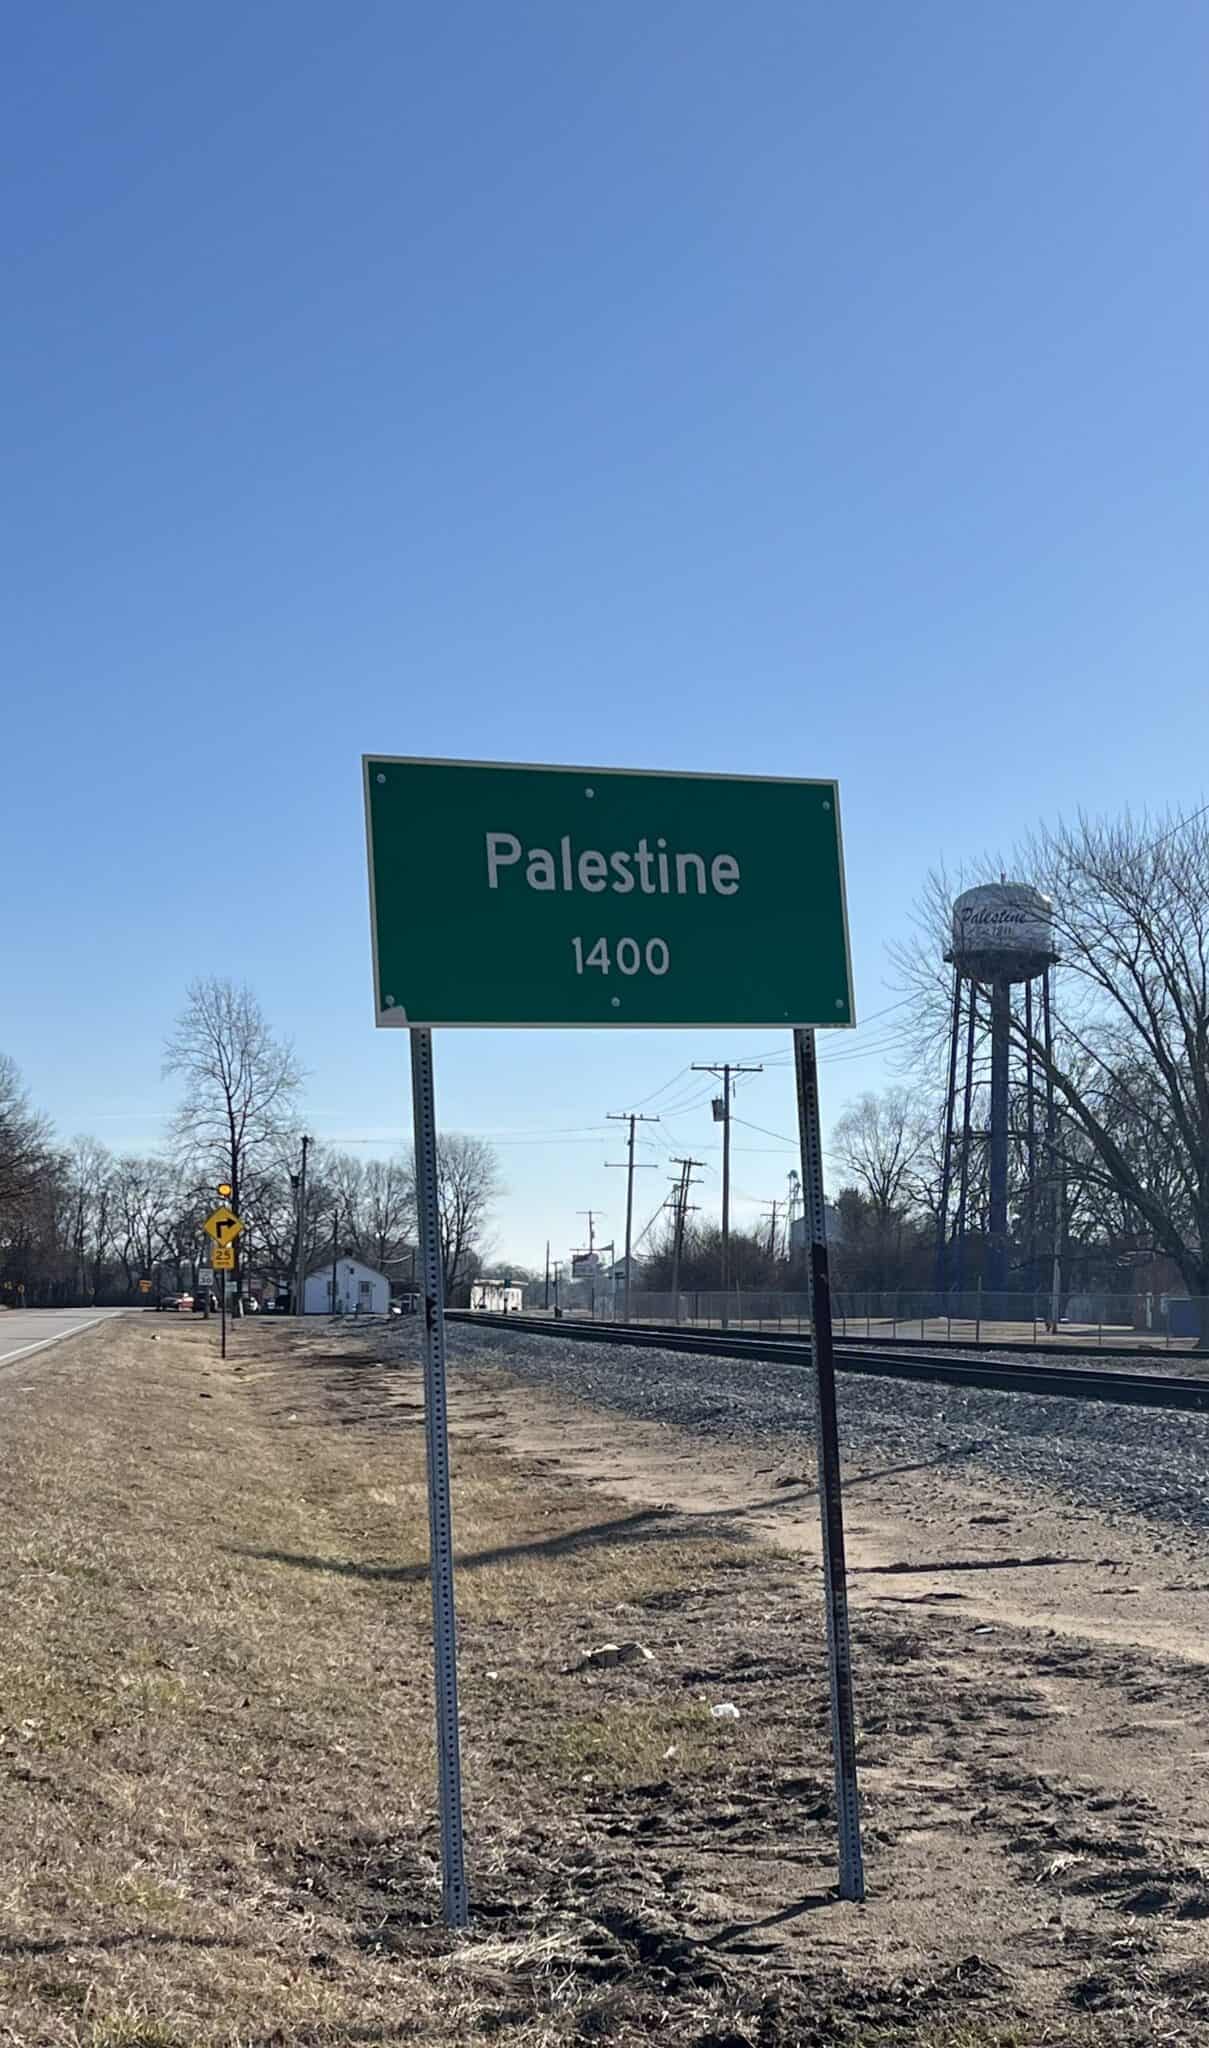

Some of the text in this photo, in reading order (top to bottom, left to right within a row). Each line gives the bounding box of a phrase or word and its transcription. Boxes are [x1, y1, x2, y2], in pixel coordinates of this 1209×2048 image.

[485, 832, 741, 896] Palestine
[571, 936, 670, 976] 1400
[215, 1250, 231, 1260] 25
